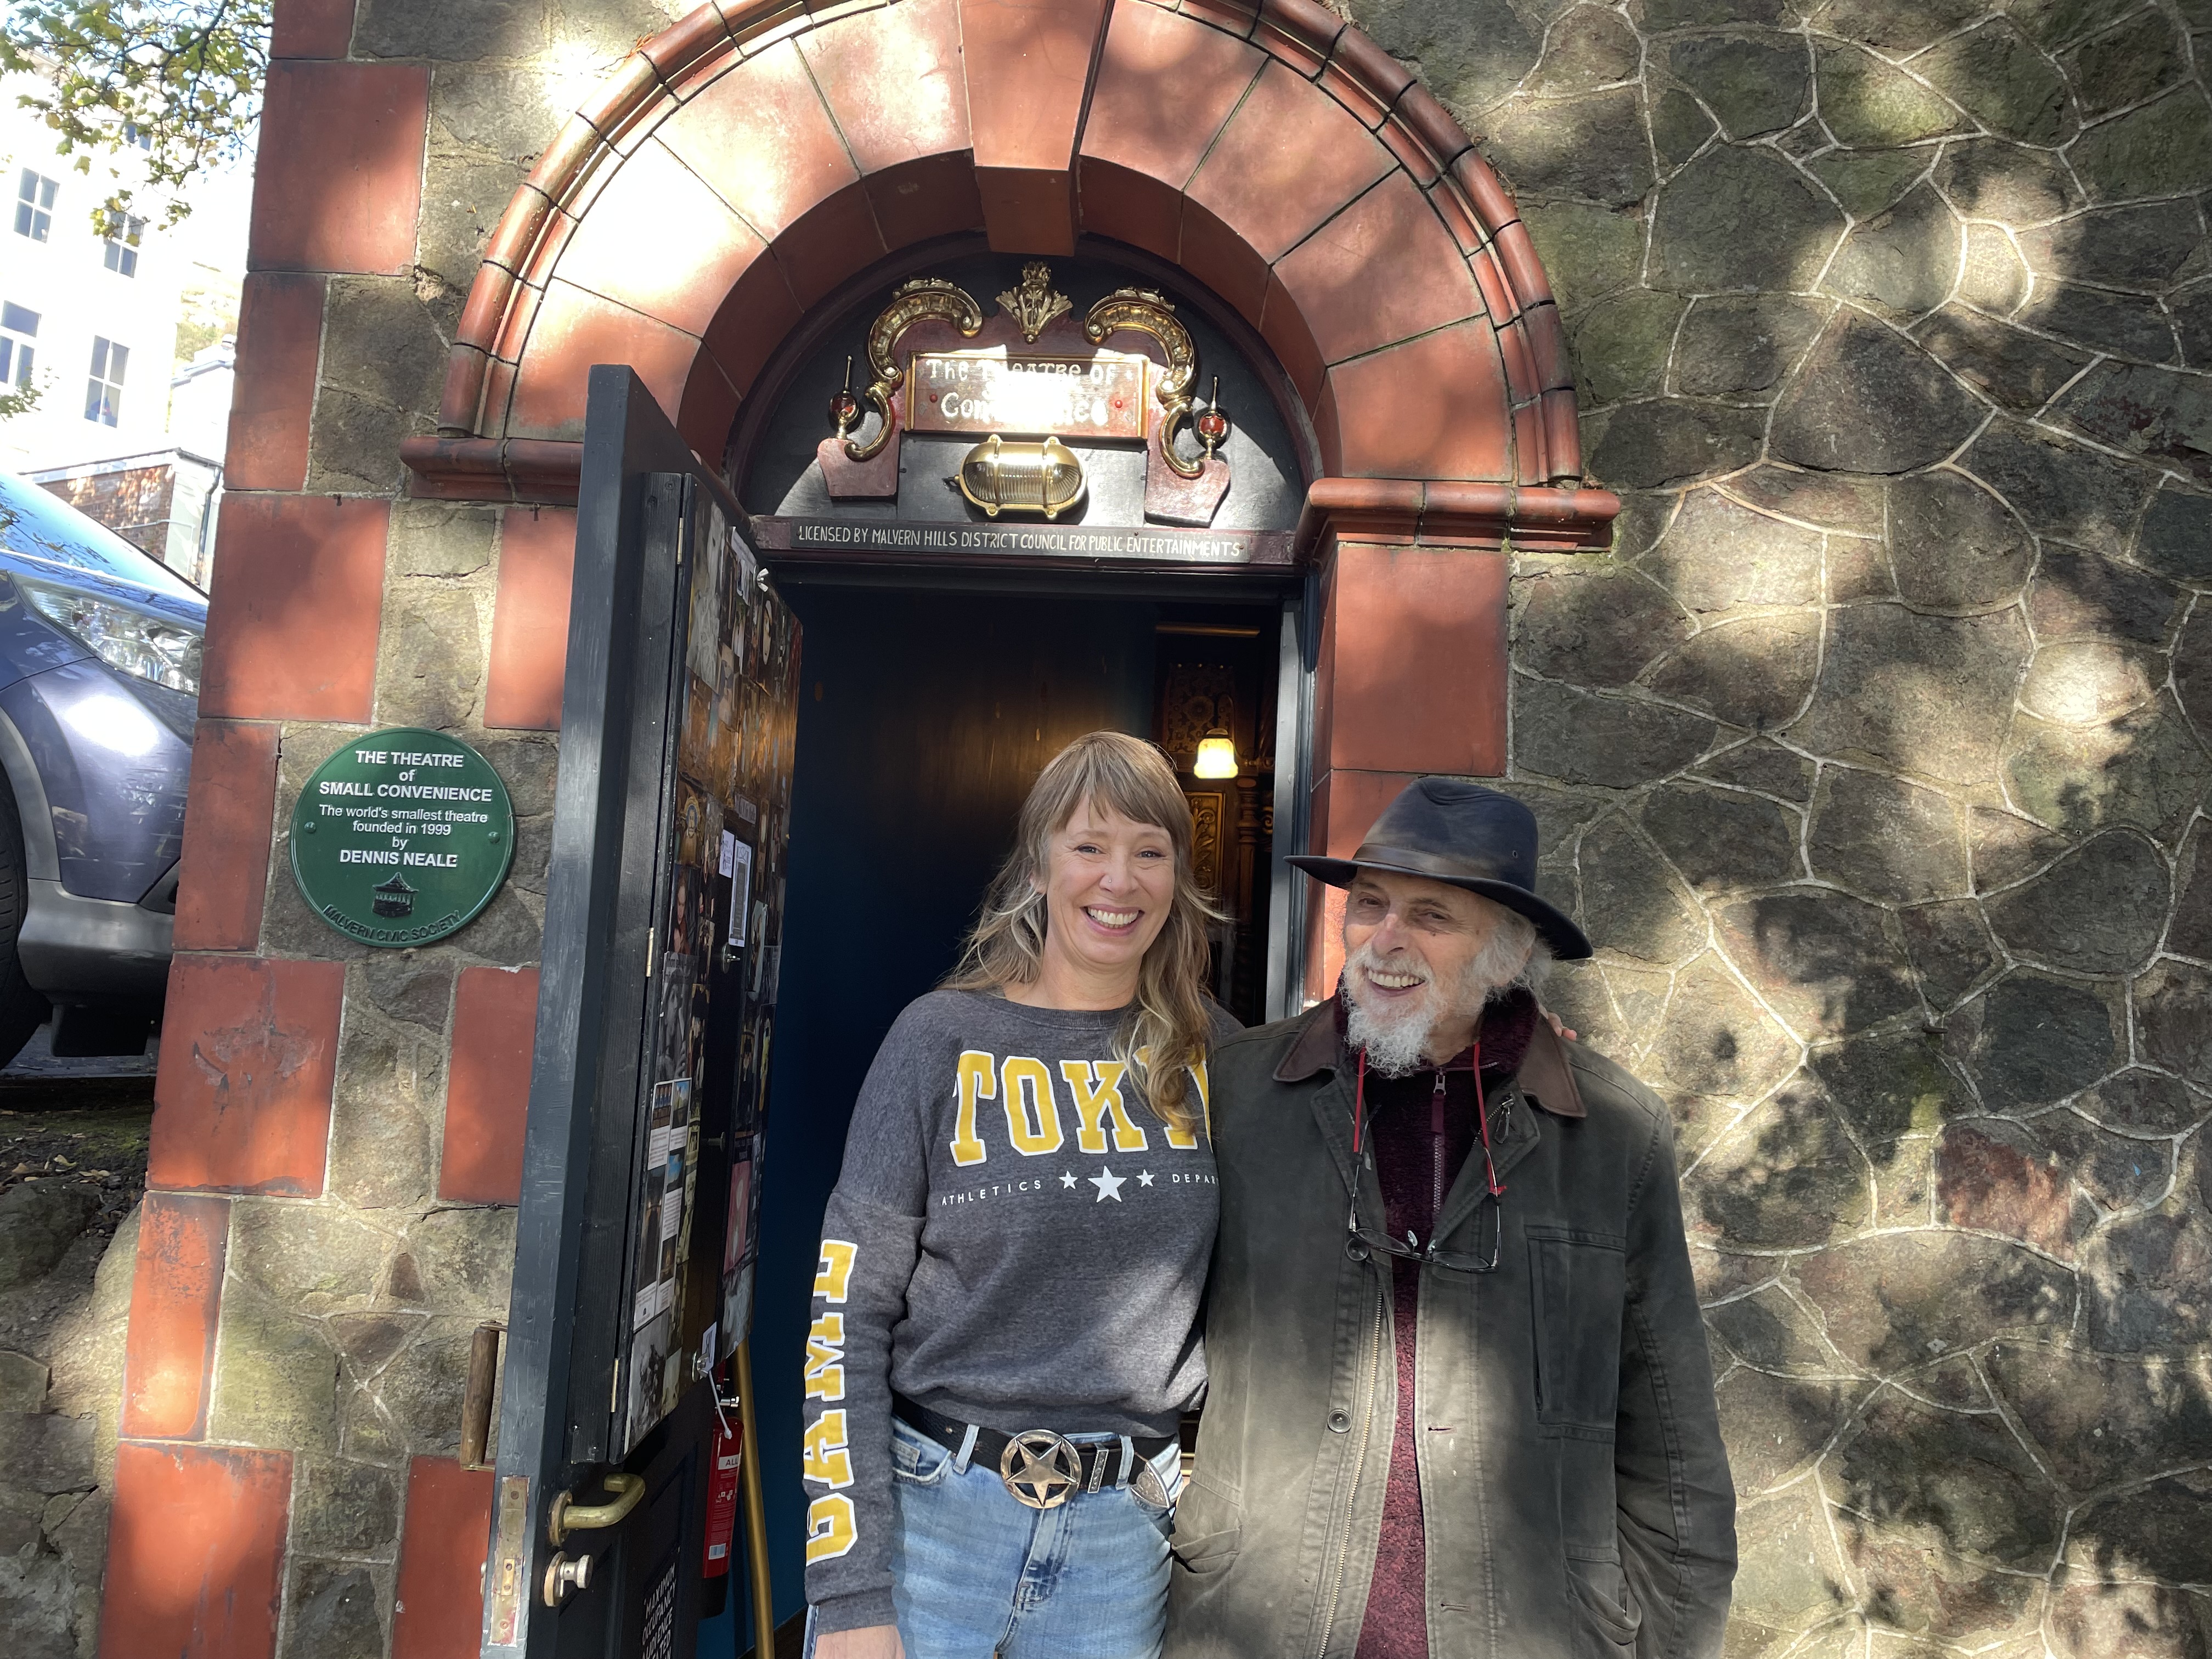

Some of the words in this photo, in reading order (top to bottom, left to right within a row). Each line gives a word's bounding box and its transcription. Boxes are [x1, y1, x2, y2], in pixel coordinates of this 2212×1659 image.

[926, 359, 969, 381] The
[799, 525, 851, 543] LICENSED
[854, 527, 869, 543] BY
[871, 528, 921, 546] MALVERN
[924, 530, 958, 548] HILLS
[961, 531, 1019, 549] DISTRICT
[1020, 533, 1069, 550] COUNCIL
[1069, 535, 1087, 551] FOR
[1088, 535, 1123, 552] PUBLIC
[1126, 537, 1241, 557] ENTERTAINMENTS
[355, 750, 387, 764] THE
[391, 752, 464, 768] THEATRE
[398, 769, 416, 782] of
[319, 781, 374, 797] SMALL
[377, 783, 493, 802] CONVENIENCE
[319, 804, 343, 817] The
[346, 805, 388, 819] world's
[391, 808, 442, 821] smallest
[445, 810, 488, 823] theatre
[352, 820, 402, 834] founded
[405, 822, 417, 834] in
[421, 823, 452, 836] 1999
[392, 837, 408, 850] by
[339, 849, 400, 865] DENNIS
[403, 852, 458, 867] NEALE
[323, 904, 376, 941] MALVERN
[376, 928, 408, 943] CIVIC
[410, 910, 462, 939] SOCIETY
[949, 1047, 1214, 1167] TOKY
[941, 1180, 1042, 1206] ATHLETICS
[642, 1578, 676, 1645] OCCUPANCY
